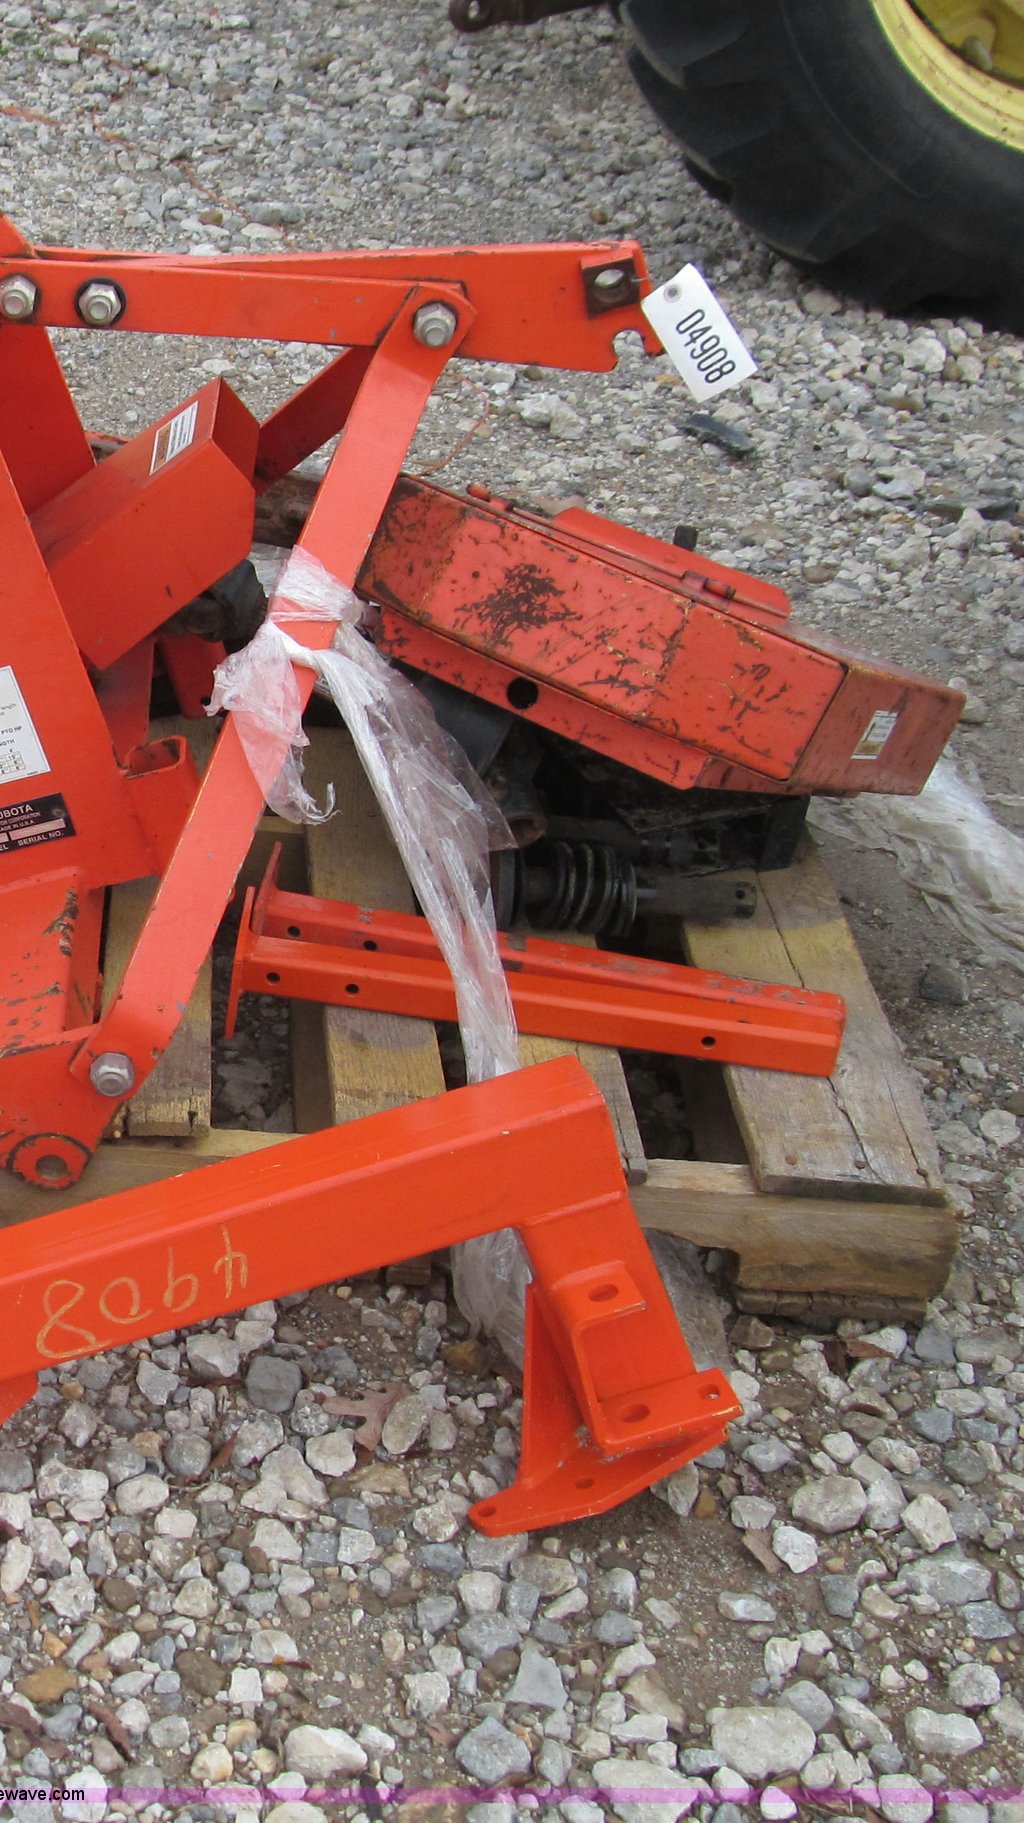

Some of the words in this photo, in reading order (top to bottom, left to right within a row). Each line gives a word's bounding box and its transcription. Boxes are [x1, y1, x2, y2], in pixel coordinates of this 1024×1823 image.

[675, 308, 736, 384] 04908
[7, 811, 41, 823] CORPORATION
[17, 833, 47, 846] SERIAL
[48, 829, 64, 838] NO.
[36, 1223, 248, 1359] 4908
